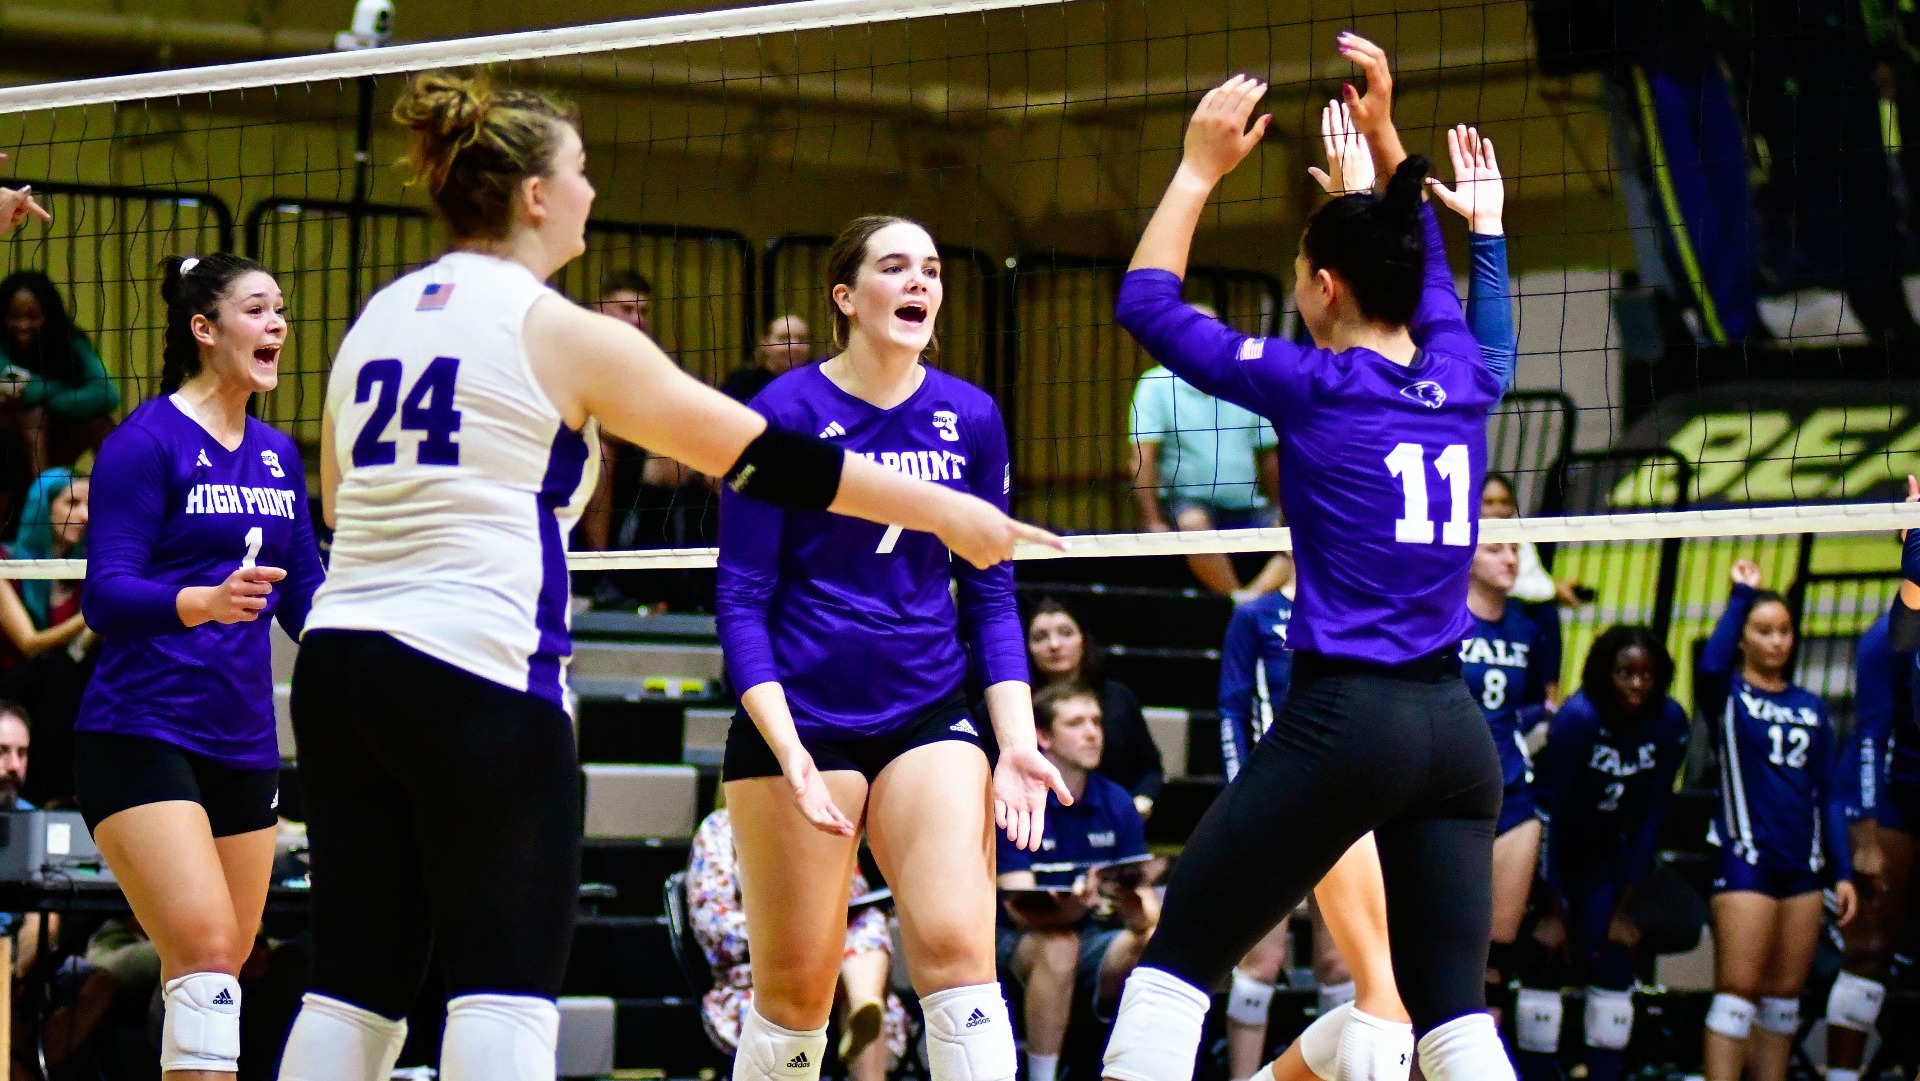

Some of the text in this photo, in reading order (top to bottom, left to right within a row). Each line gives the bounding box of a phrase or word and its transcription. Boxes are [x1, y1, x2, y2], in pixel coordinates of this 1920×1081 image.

[352, 356, 461, 468] 24
[881, 450, 966, 481] POINT
[186, 484, 295, 519] HIGH POINT
[1384, 442, 1471, 546] 11
[239, 527, 263, 570] 1
[1483, 669, 1507, 710] 8
[1767, 725, 1810, 768] 12
